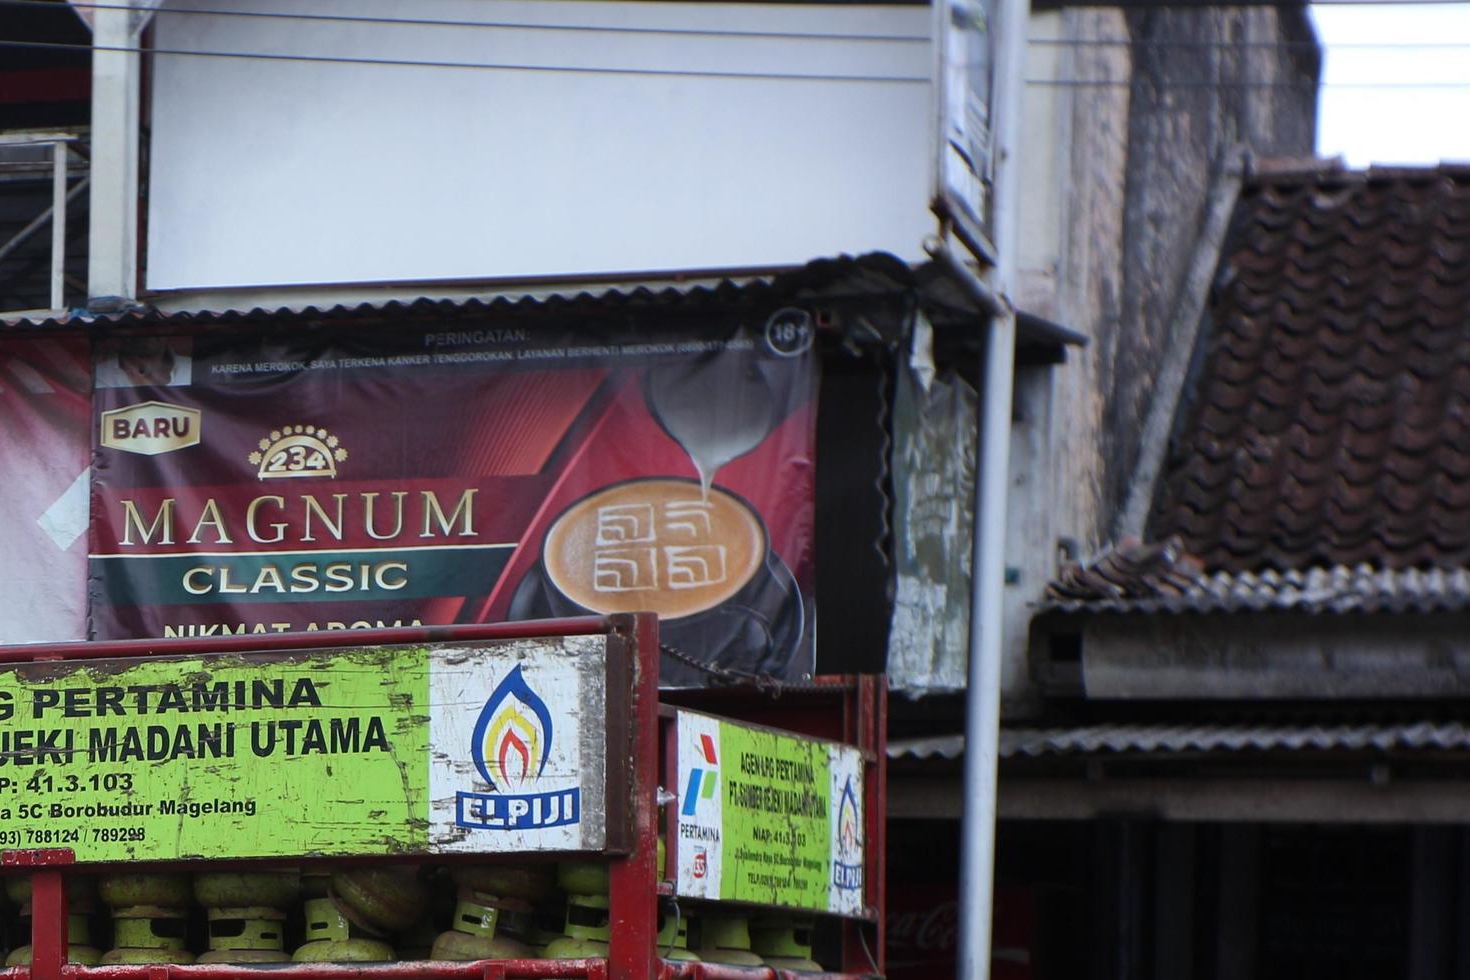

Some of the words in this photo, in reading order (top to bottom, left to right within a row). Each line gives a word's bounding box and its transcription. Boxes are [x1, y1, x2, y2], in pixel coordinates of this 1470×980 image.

[425, 328, 531, 347] PERINGATAN:
[774, 323, 808, 342] 18+
[212, 363, 253, 374] KARENA
[311, 359, 337, 370] SAYA
[339, 357, 386, 369] TERKENA
[388, 354, 430, 366] KANKER
[518, 348, 566, 360] LAYANAN
[567, 346, 619, 358] BERHENTI
[113, 417, 190, 442] BARU
[269, 444, 326, 472] 234
[119, 488, 481, 547] MAGNUM
[182, 561, 409, 595] CLASSIC
[33, 677, 323, 719] PERTAMINA
[88, 722, 236, 763] MADANI
[251, 716, 389, 758] UTAMA
[26, 773, 134, 793] 41.3.103
[18, 804, 43, 819] 5C
[49, 801, 154, 818] Borobudur
[159, 798, 257, 818] Magelang
[462, 794, 573, 826] ELPIJI
[27, 828, 79, 844] 788124
[681, 823, 720, 842] PERTAMINA
